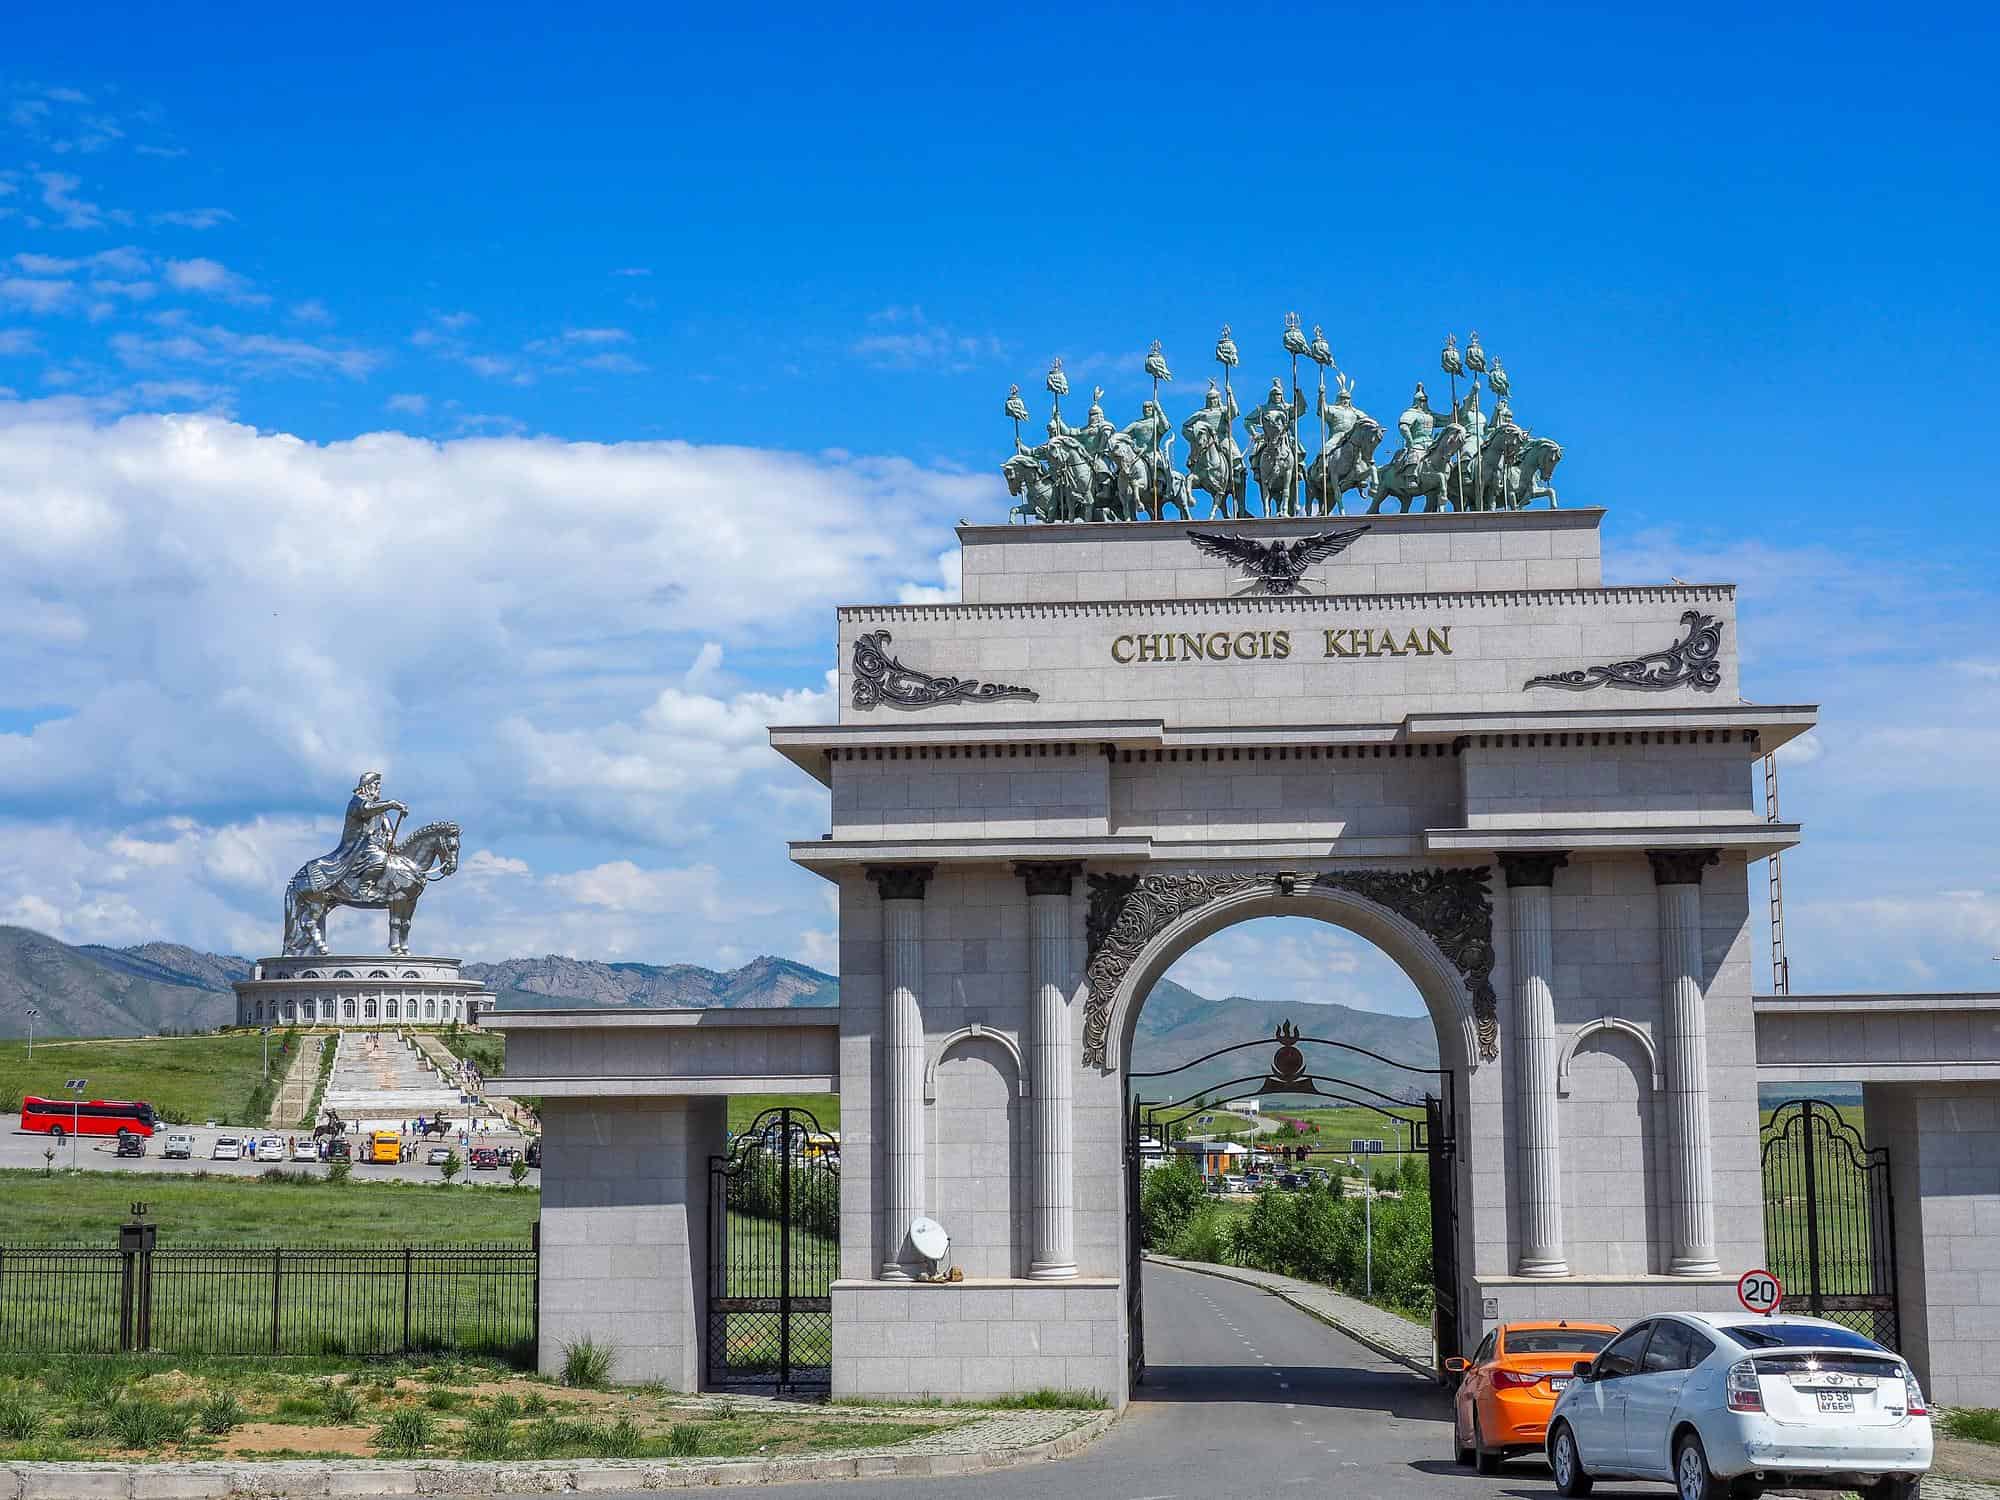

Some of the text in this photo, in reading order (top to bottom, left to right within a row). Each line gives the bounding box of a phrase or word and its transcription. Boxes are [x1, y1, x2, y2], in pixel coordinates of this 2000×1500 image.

[1111, 626, 1453, 664] CHINGGIS KHAAN
[1746, 1279, 1775, 1303] 20
